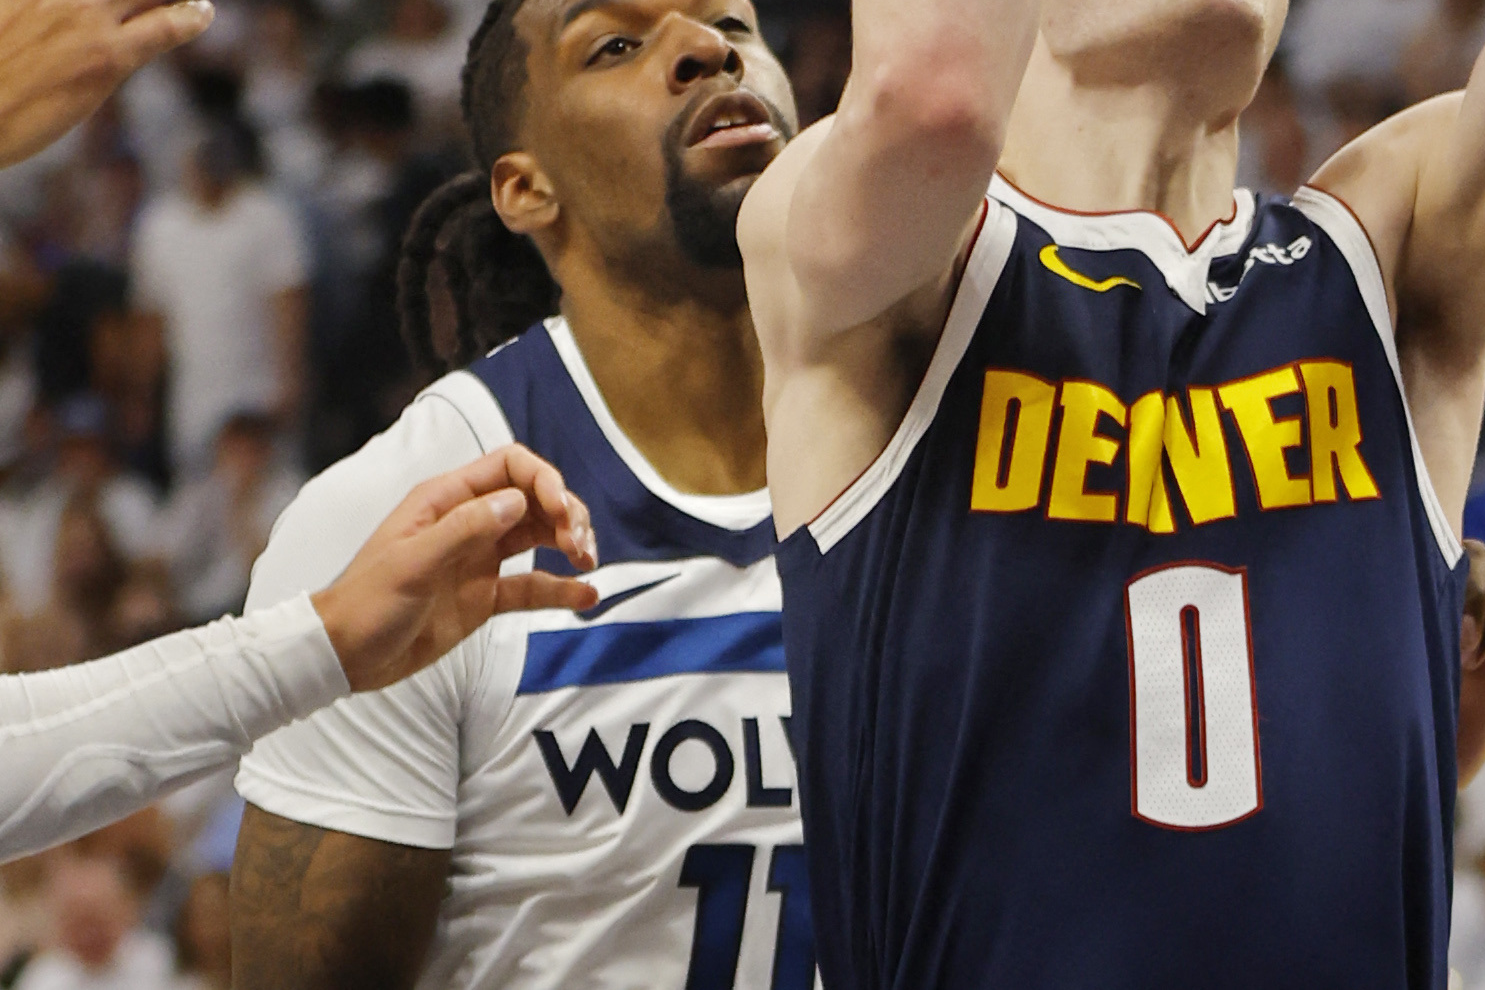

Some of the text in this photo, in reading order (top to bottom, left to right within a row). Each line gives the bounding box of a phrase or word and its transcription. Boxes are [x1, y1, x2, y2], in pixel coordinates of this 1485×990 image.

[531, 718, 798, 817] WOL
[1126, 560, 1264, 833] 0
[678, 844, 818, 990] 11
